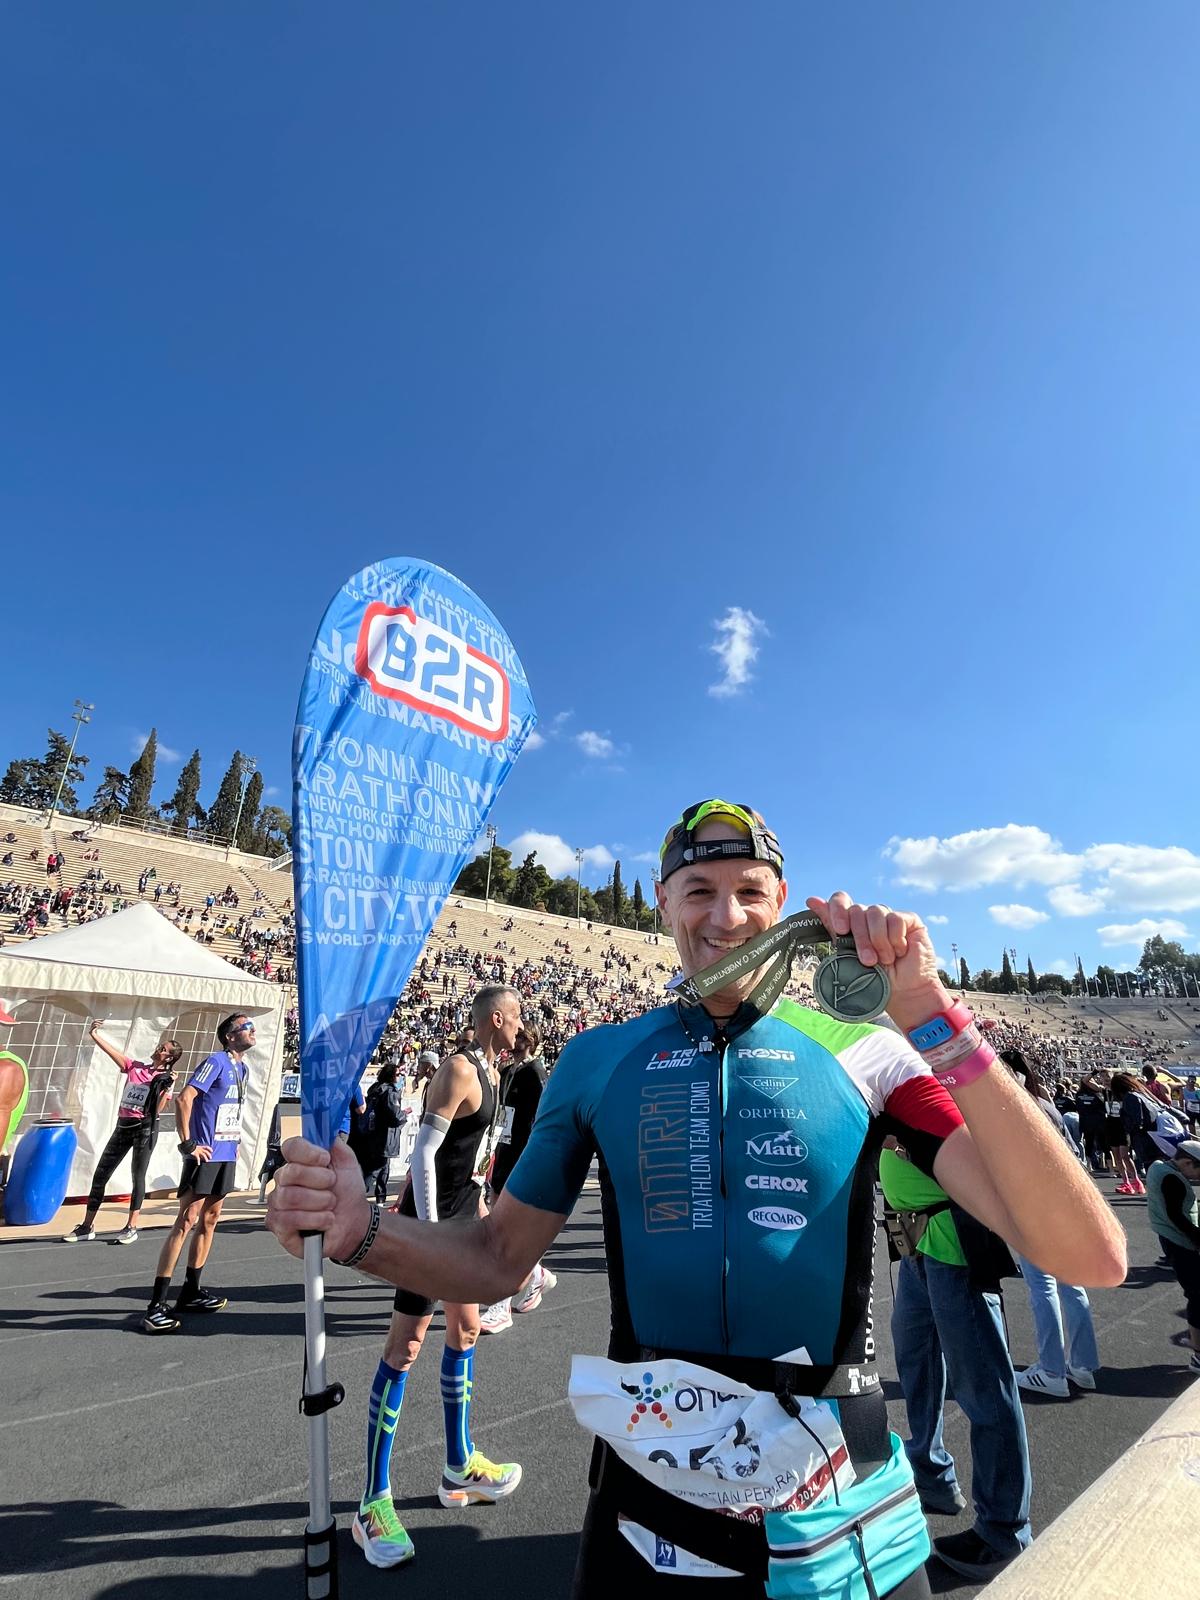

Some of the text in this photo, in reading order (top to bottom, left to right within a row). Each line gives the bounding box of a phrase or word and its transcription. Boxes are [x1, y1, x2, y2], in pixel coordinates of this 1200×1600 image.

[380, 622, 495, 723] B2R
[345, 802, 378, 826] YORK
[298, 828, 375, 874] STON
[315, 931, 376, 946] WORLD
[671, 1048, 699, 1058] TRI
[645, 1058, 695, 1071] COMO
[739, 1108, 809, 1120] ORPHEA
[689, 1081, 713, 1230] TRIATHLON TEAM COMO
[745, 1140, 804, 1157] Matt
[744, 1174, 809, 1194] CEROX
[752, 1210, 804, 1225] RECOARO
